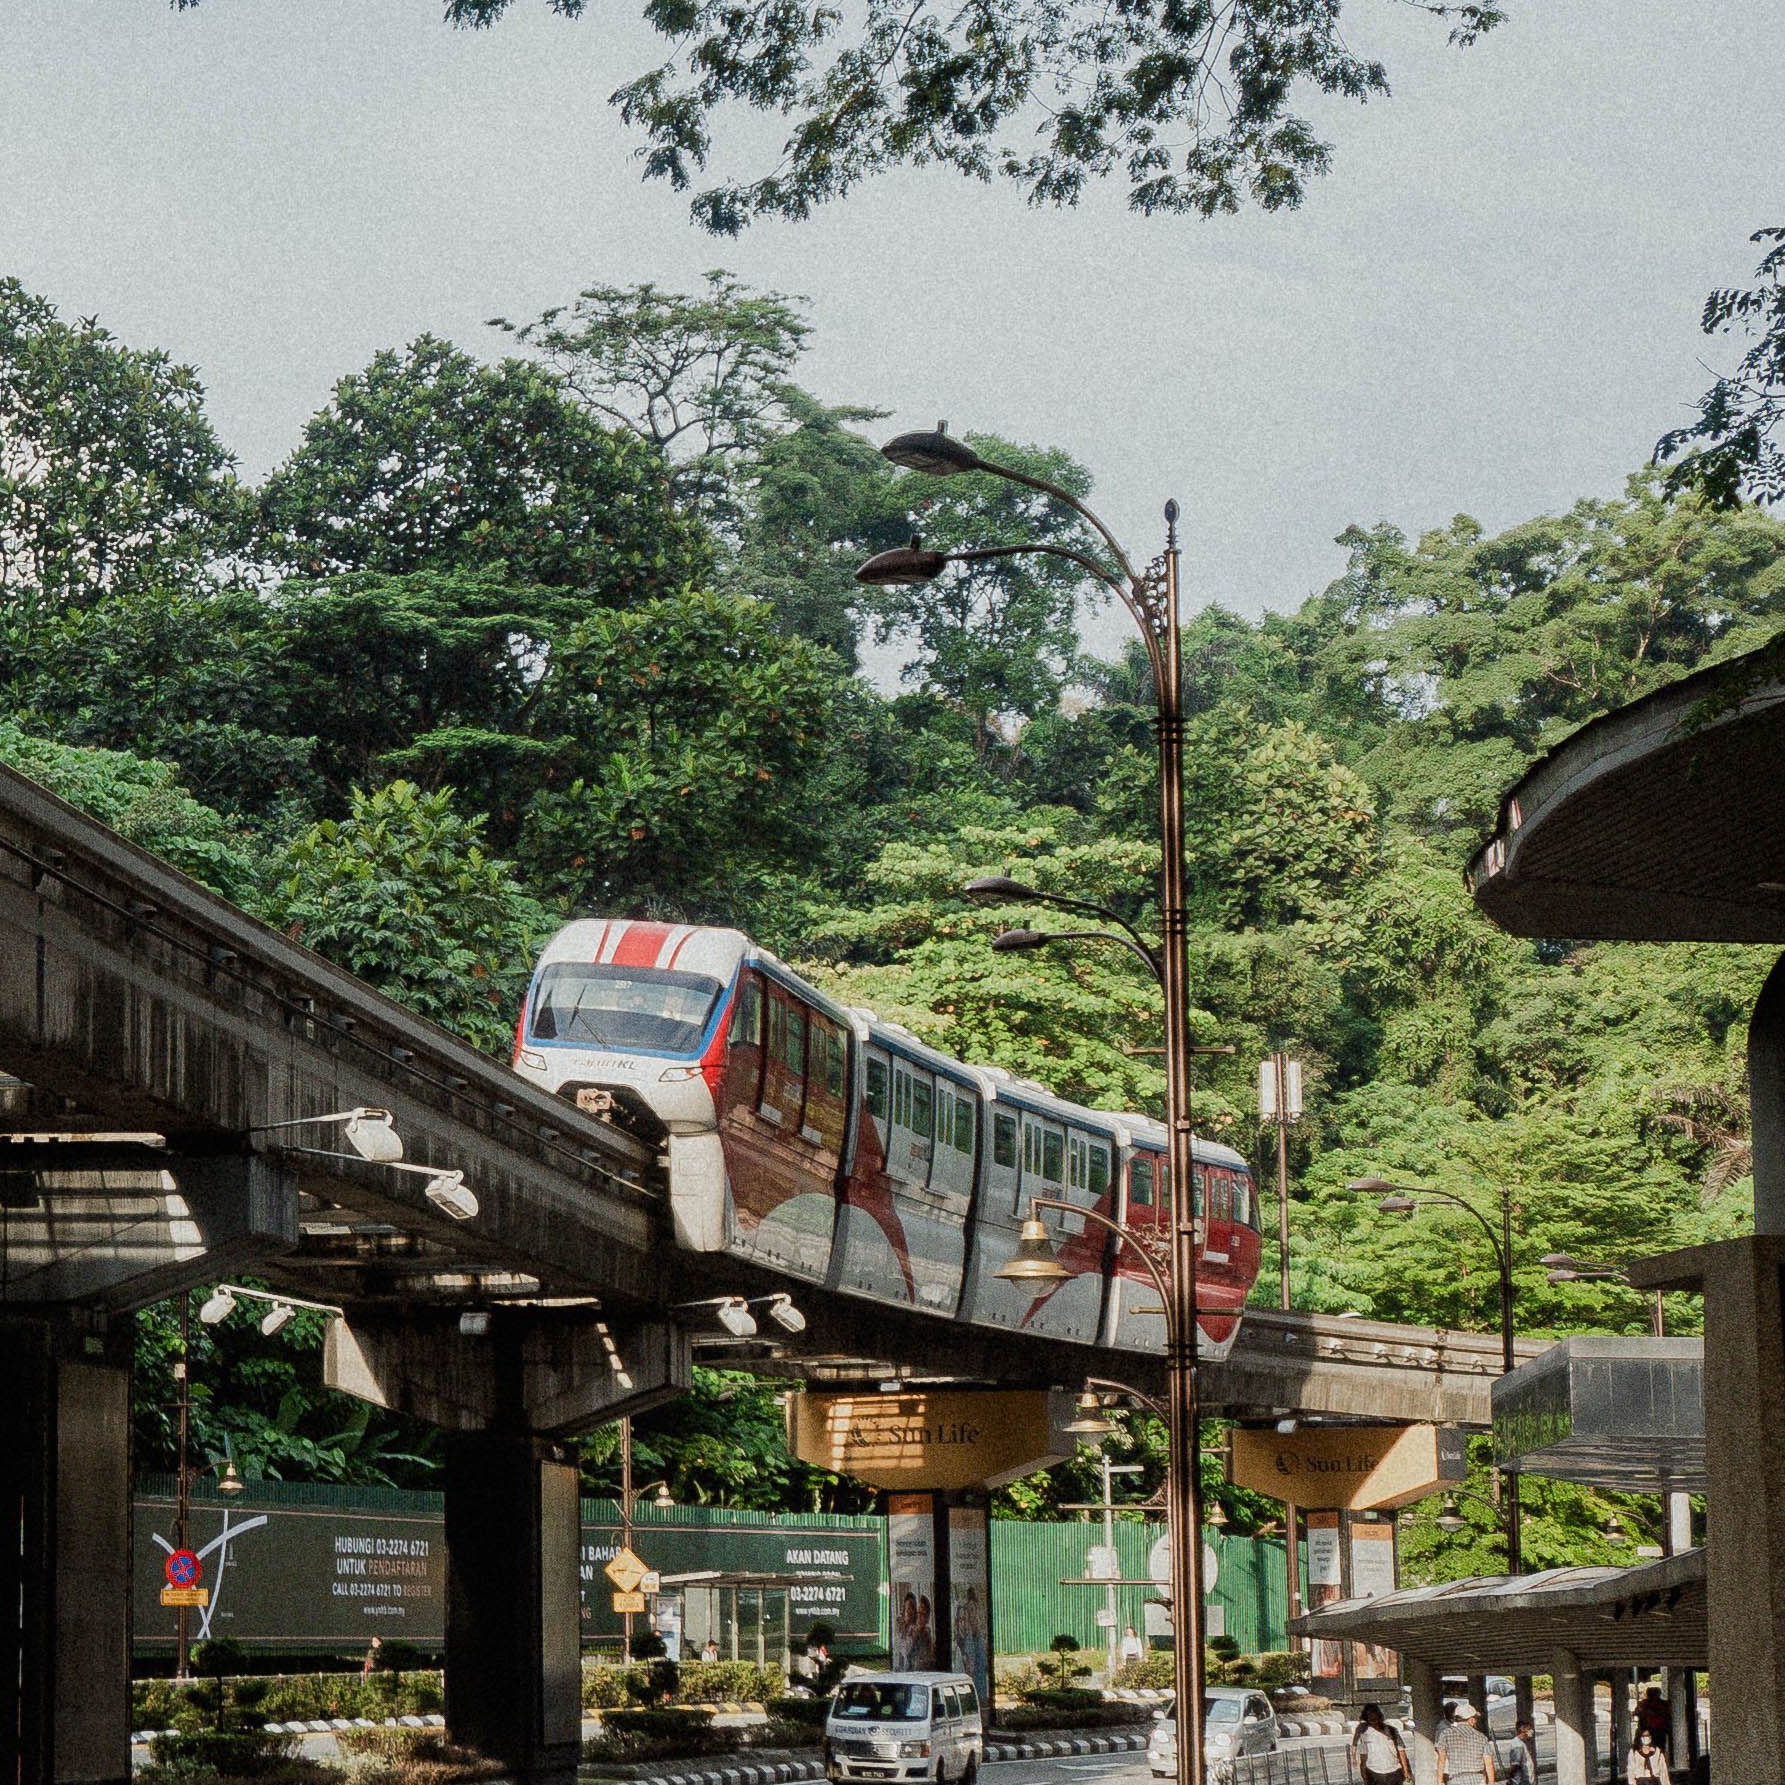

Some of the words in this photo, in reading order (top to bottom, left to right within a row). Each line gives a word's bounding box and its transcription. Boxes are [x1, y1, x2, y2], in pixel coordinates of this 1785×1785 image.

[888, 1424, 932, 1445] Sun
[937, 1422, 980, 1445] Life
[1306, 1457, 1341, 1473] Sun
[334, 1535, 375, 1555] HUBUNGI
[376, 1537, 409, 1556] 03-2274
[410, 1539, 429, 1557] 6721
[786, 1549, 812, 1565] AKAN
[813, 1550, 849, 1566] DATANG
[336, 1557, 367, 1576] UNTUK
[368, 1559, 428, 1577] PENDAFTARAN
[332, 1582, 349, 1596] CALL
[349, 1582, 375, 1597] 03-2274
[376, 1583, 392, 1597] 6721
[392, 1583, 402, 1598] TO
[403, 1584, 432, 1598] REGISTER
[790, 1585, 825, 1602] 03-2274
[825, 1586, 846, 1602] 6721
